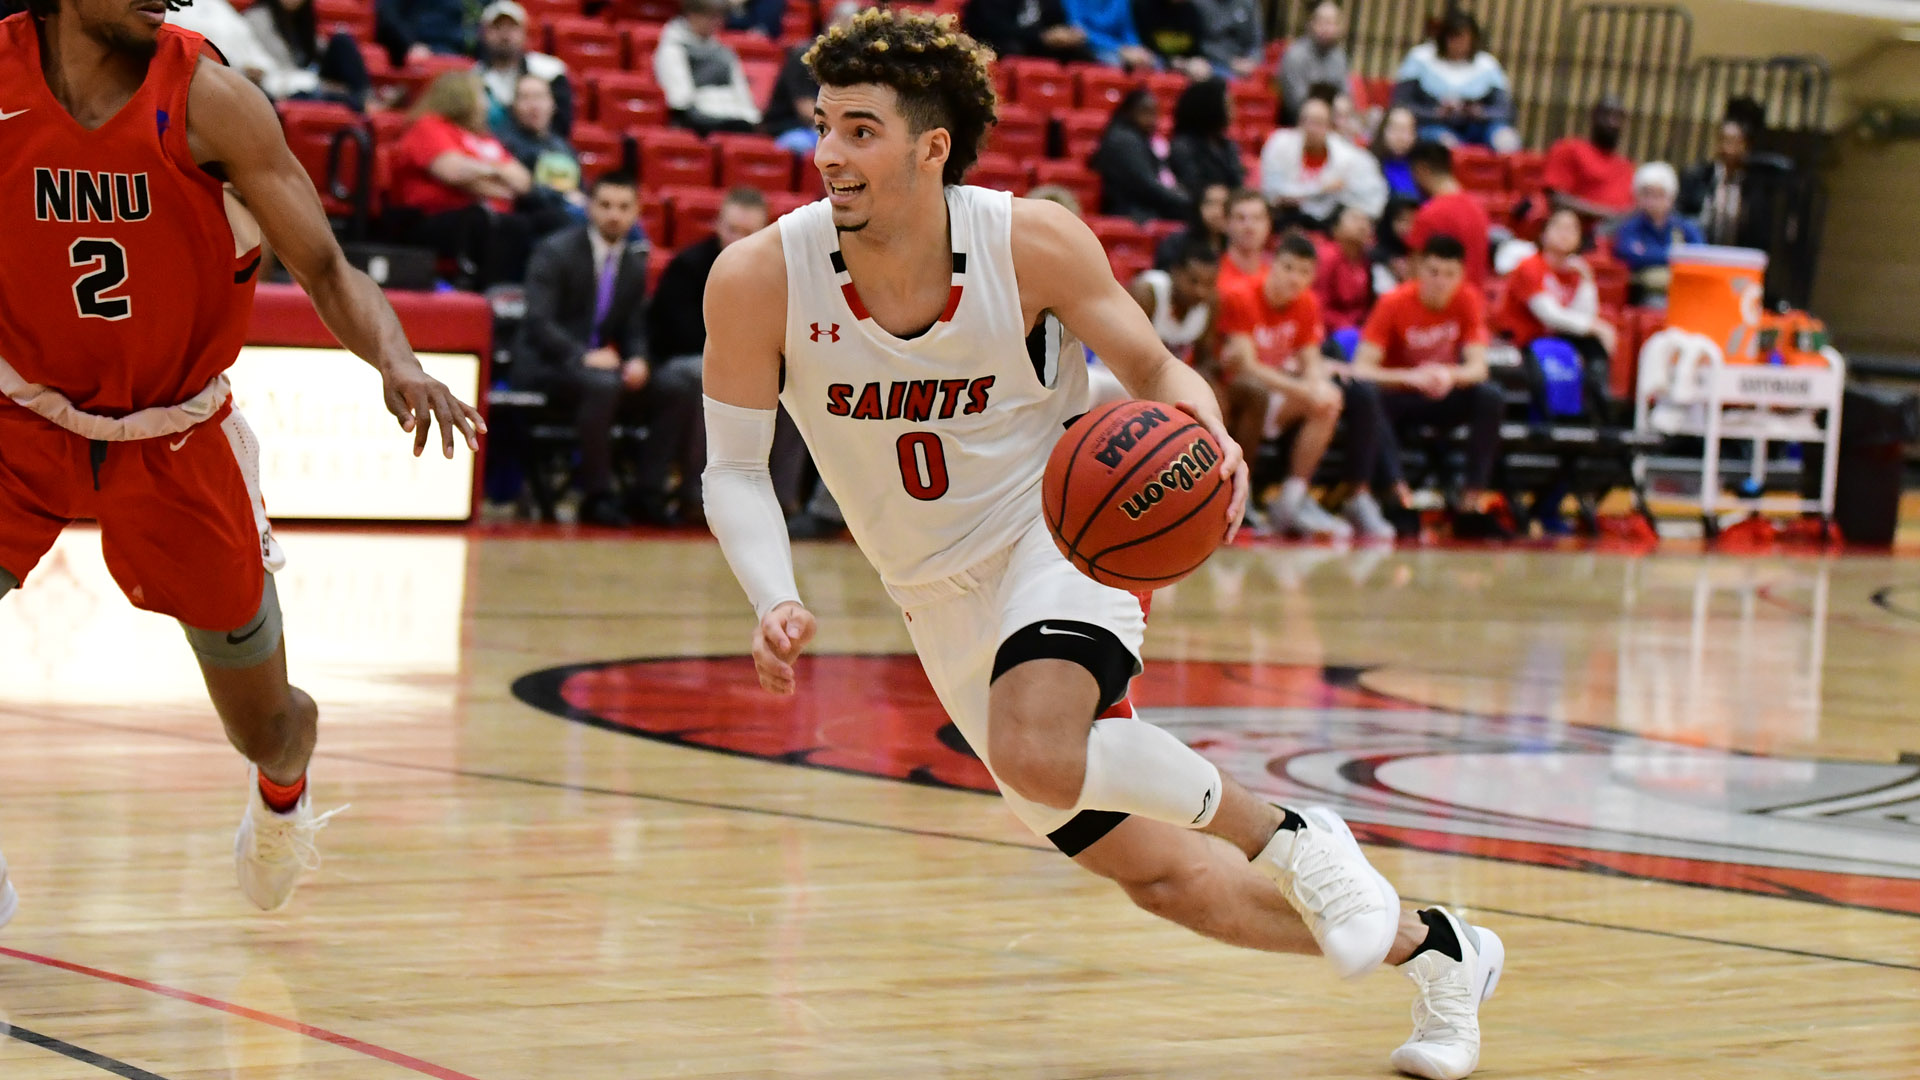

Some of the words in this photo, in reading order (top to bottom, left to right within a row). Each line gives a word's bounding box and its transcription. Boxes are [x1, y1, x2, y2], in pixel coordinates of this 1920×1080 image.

[34, 167, 152, 223] NNU
[68, 236, 132, 321] 2
[826, 375, 996, 422] SAINTS
[896, 431, 949, 501] 0
[1095, 407, 1170, 469] NCAA
[1118, 437, 1219, 520] Wilson
